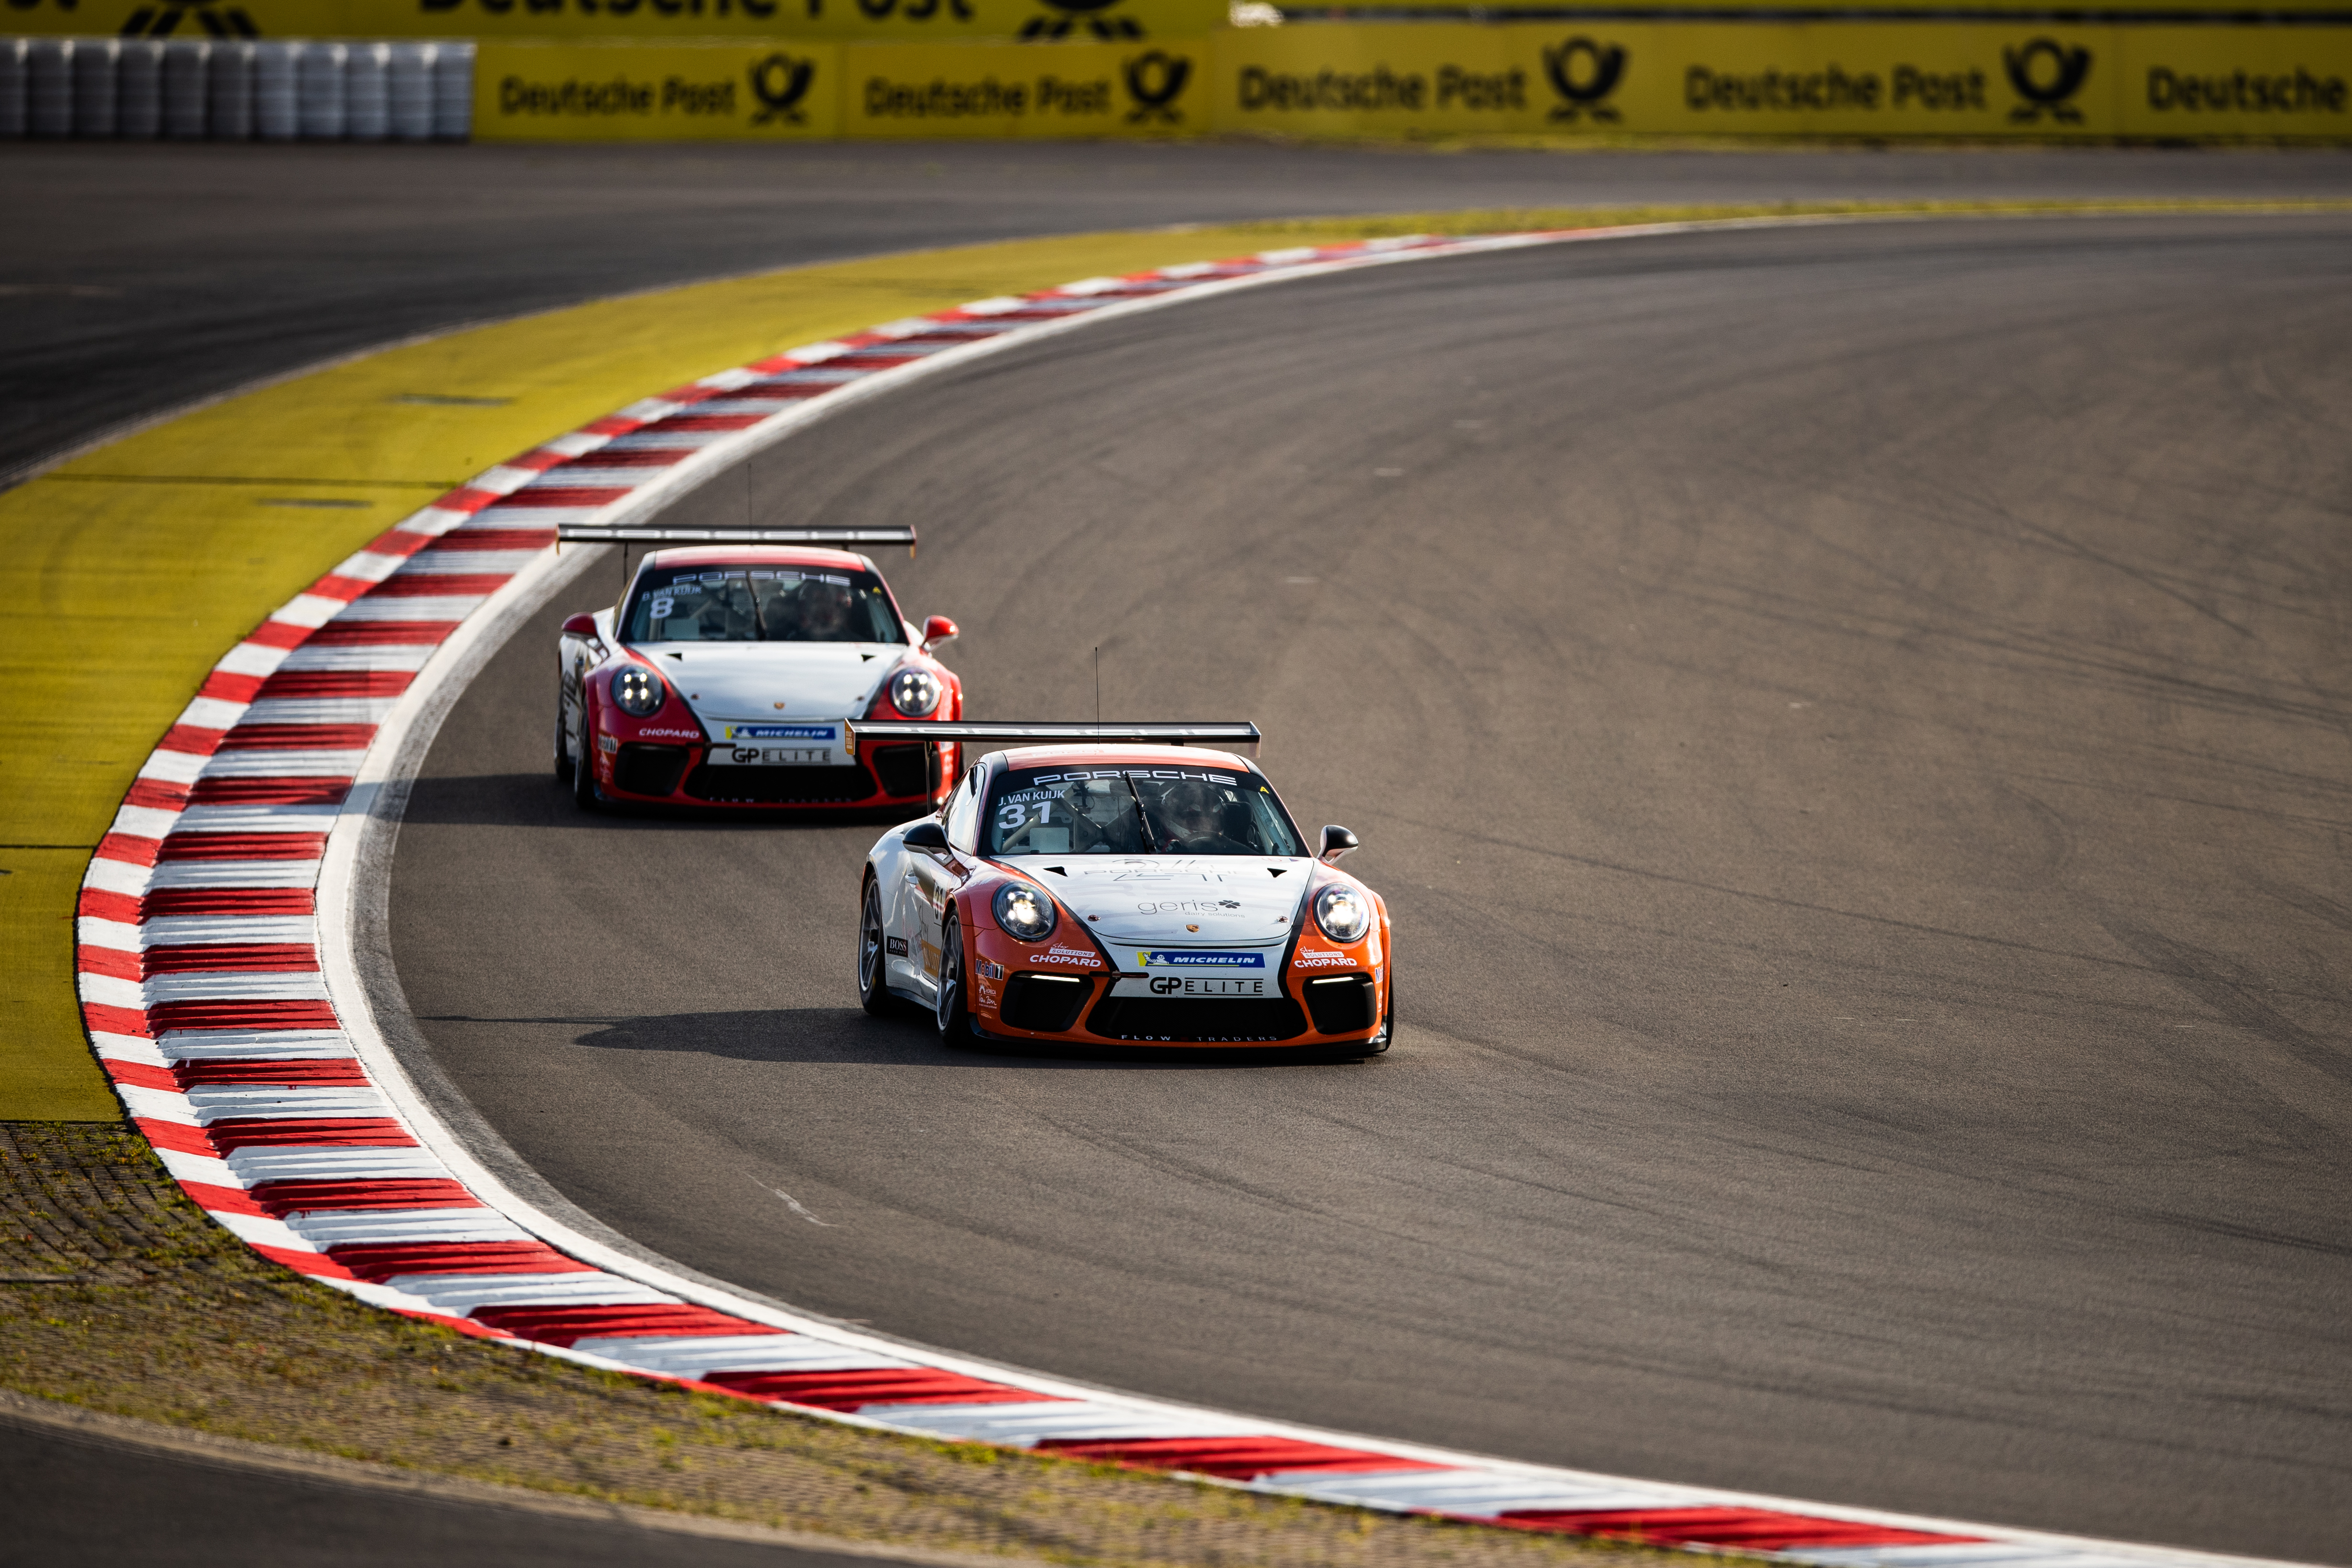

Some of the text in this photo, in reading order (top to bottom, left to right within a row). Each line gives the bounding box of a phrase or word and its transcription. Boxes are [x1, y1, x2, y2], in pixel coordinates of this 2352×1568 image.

[1237, 63, 1529, 113] Deutsche Post
[1684, 63, 1989, 111] Deutsche Post
[2149, 63, 2349, 113] Deutsche
[499, 75, 737, 116] Deutsche Post
[864, 76, 1112, 118] Deutsche Post
[673, 571, 851, 586] PORSCHE
[650, 597, 674, 619] 8
[639, 728, 699, 739] CHOPARD
[755, 729, 828, 737] MICHELIN
[860, 725, 1246, 735] PORSCHE
[1034, 770, 1237, 786] PORSCHE
[998, 790, 1066, 806] J. VAN KUIJK
[998, 800, 1051, 829] 31
[1137, 899, 1219, 915] geris
[890, 939, 906, 952] BOSS
[975, 959, 994, 979] Mobil
[1029, 955, 1101, 967] CHOPARD
[1294, 958, 1358, 968] CHOPARD
